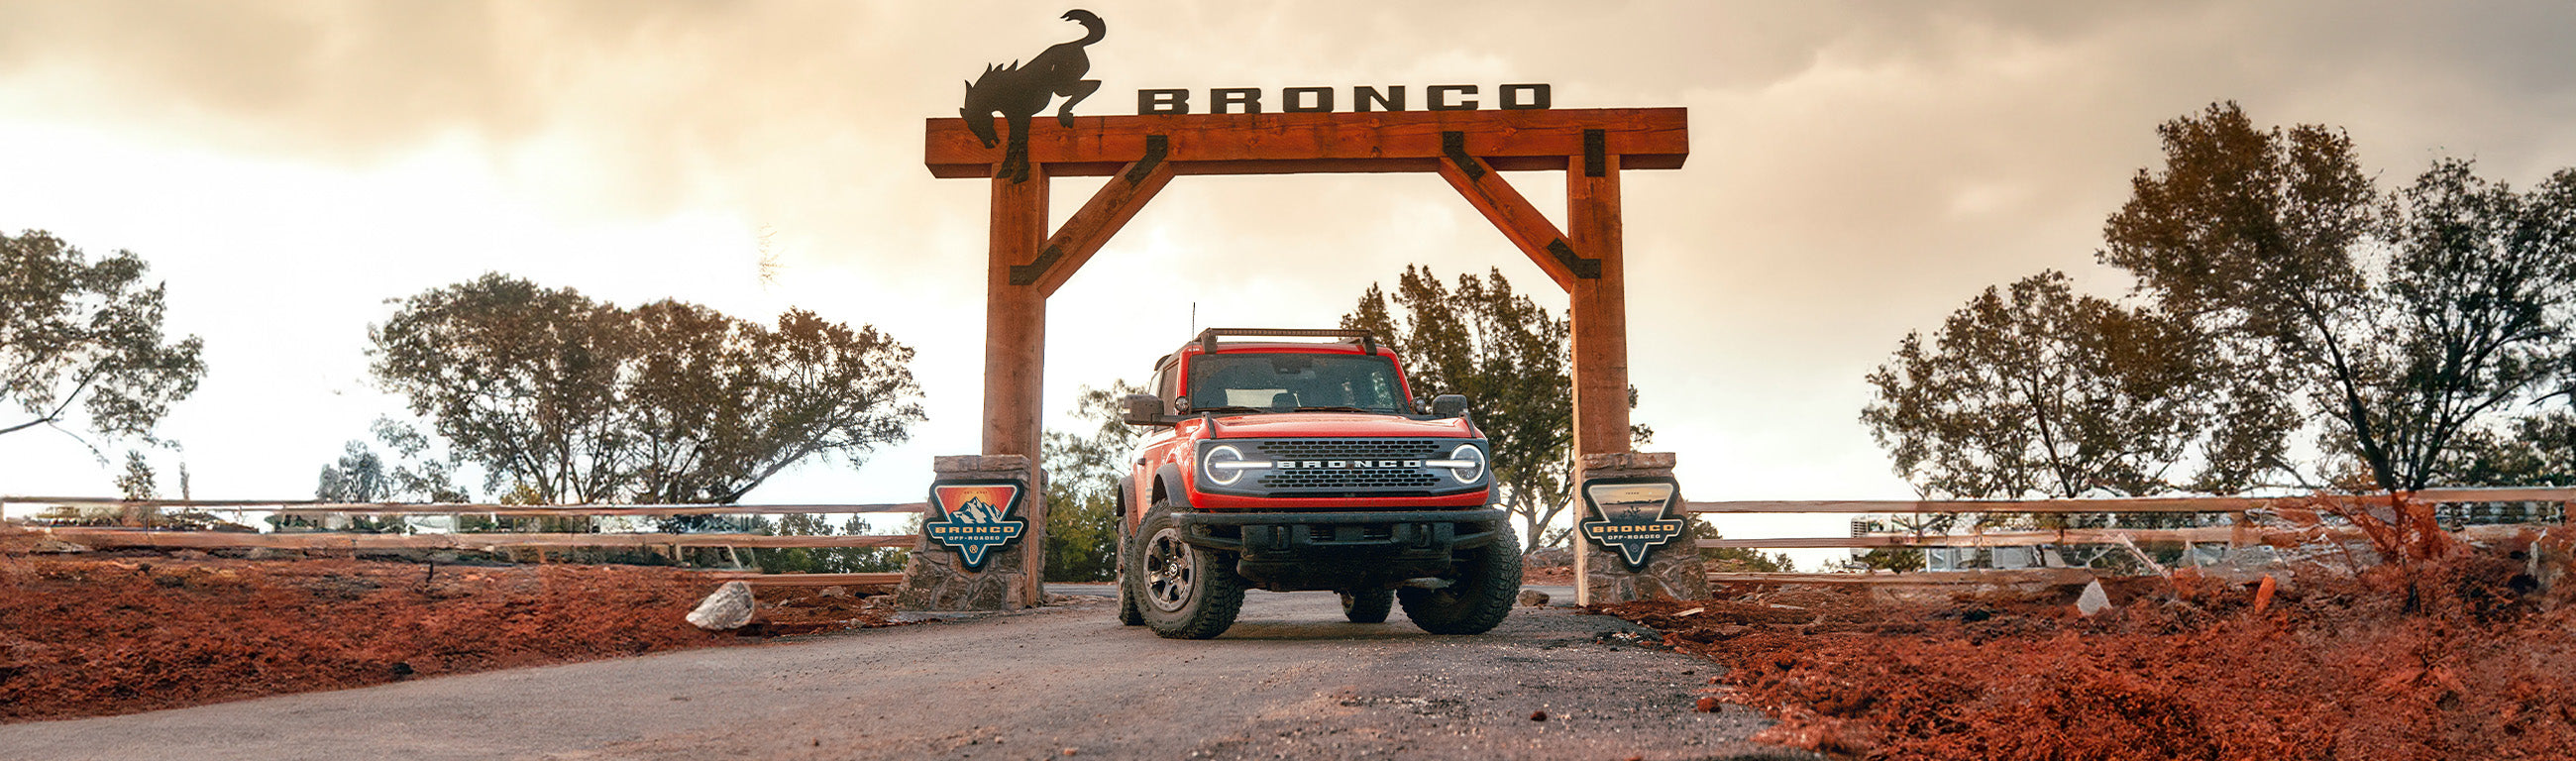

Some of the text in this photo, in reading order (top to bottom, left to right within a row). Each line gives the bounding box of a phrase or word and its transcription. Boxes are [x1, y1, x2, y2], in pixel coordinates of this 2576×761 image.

[1137, 83, 1552, 115] BRONCO
[1277, 460, 1421, 469] BRONCO
[1592, 524, 1674, 533] BRONCO
